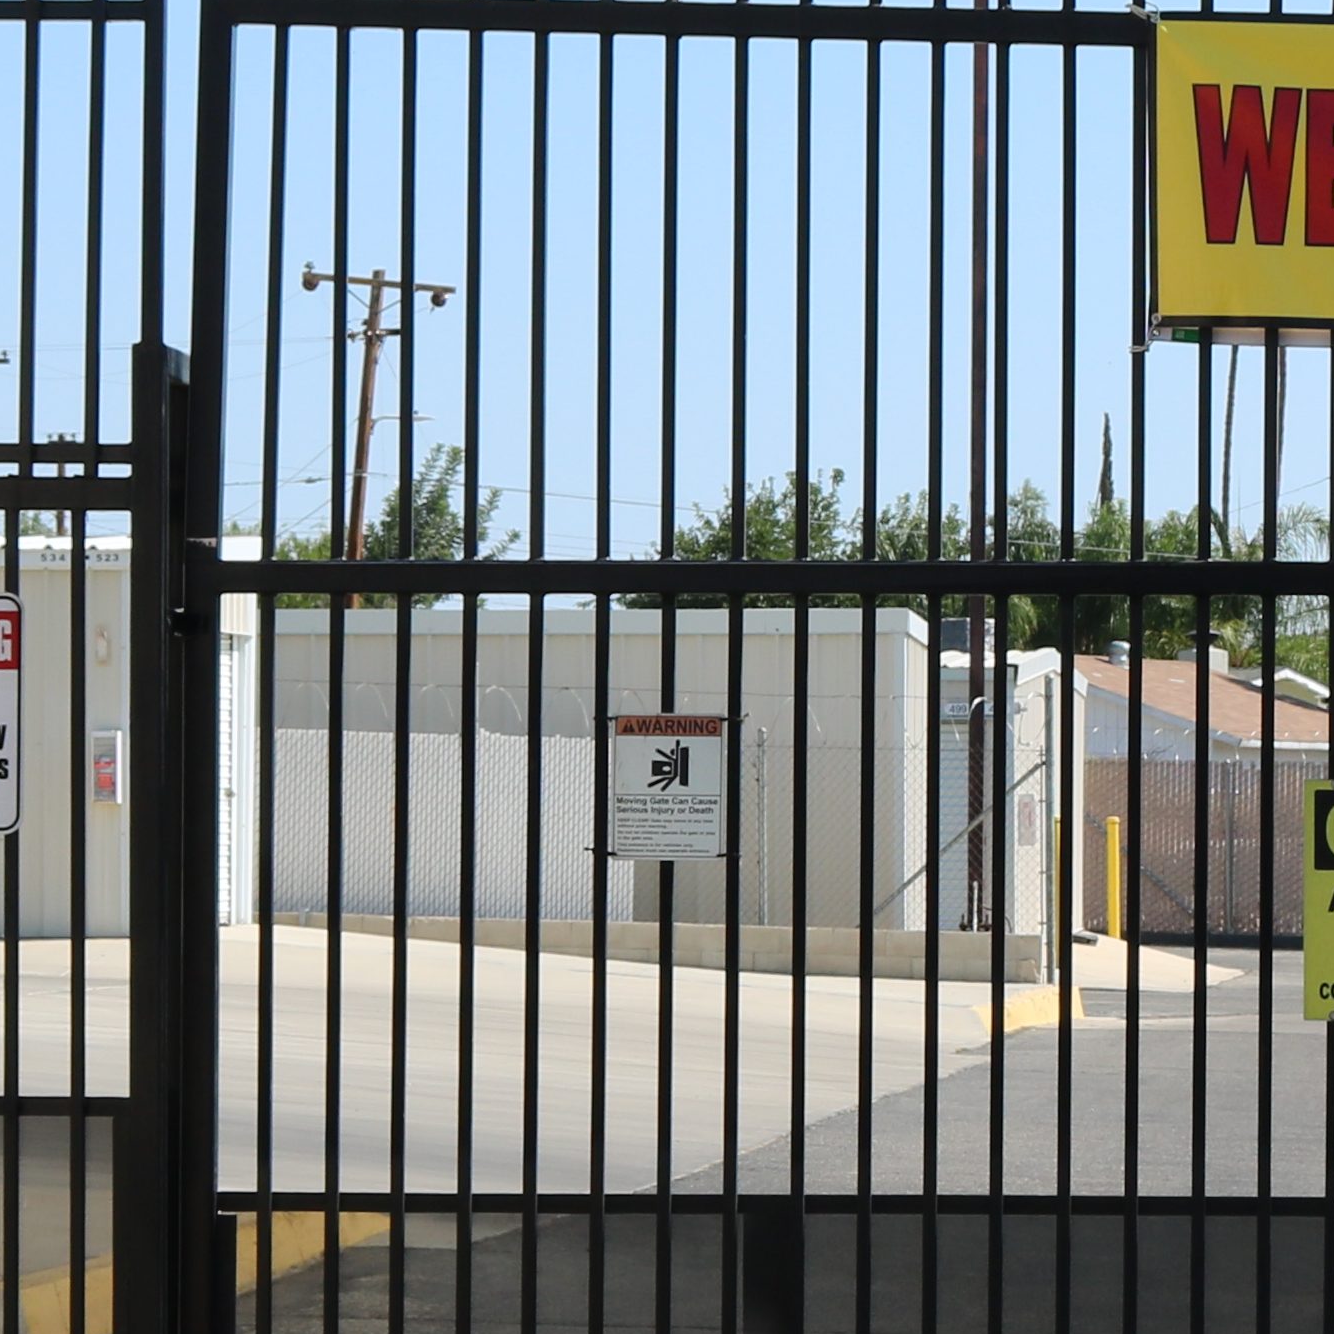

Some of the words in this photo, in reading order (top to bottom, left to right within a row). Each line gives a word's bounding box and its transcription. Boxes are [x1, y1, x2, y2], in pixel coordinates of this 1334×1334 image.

[40, 553, 66, 562] 534
[96, 553, 120, 562] 523
[636, 719, 718, 734] WARNING
[616, 797, 647, 806] Moving
[649, 796, 670, 805] Gate
[671, 797, 689, 805] Can
[691, 797, 719, 805] Cause
[616, 806, 648, 814] Serious
[650, 806, 675, 815] Injury
[688, 806, 714, 814] Death
